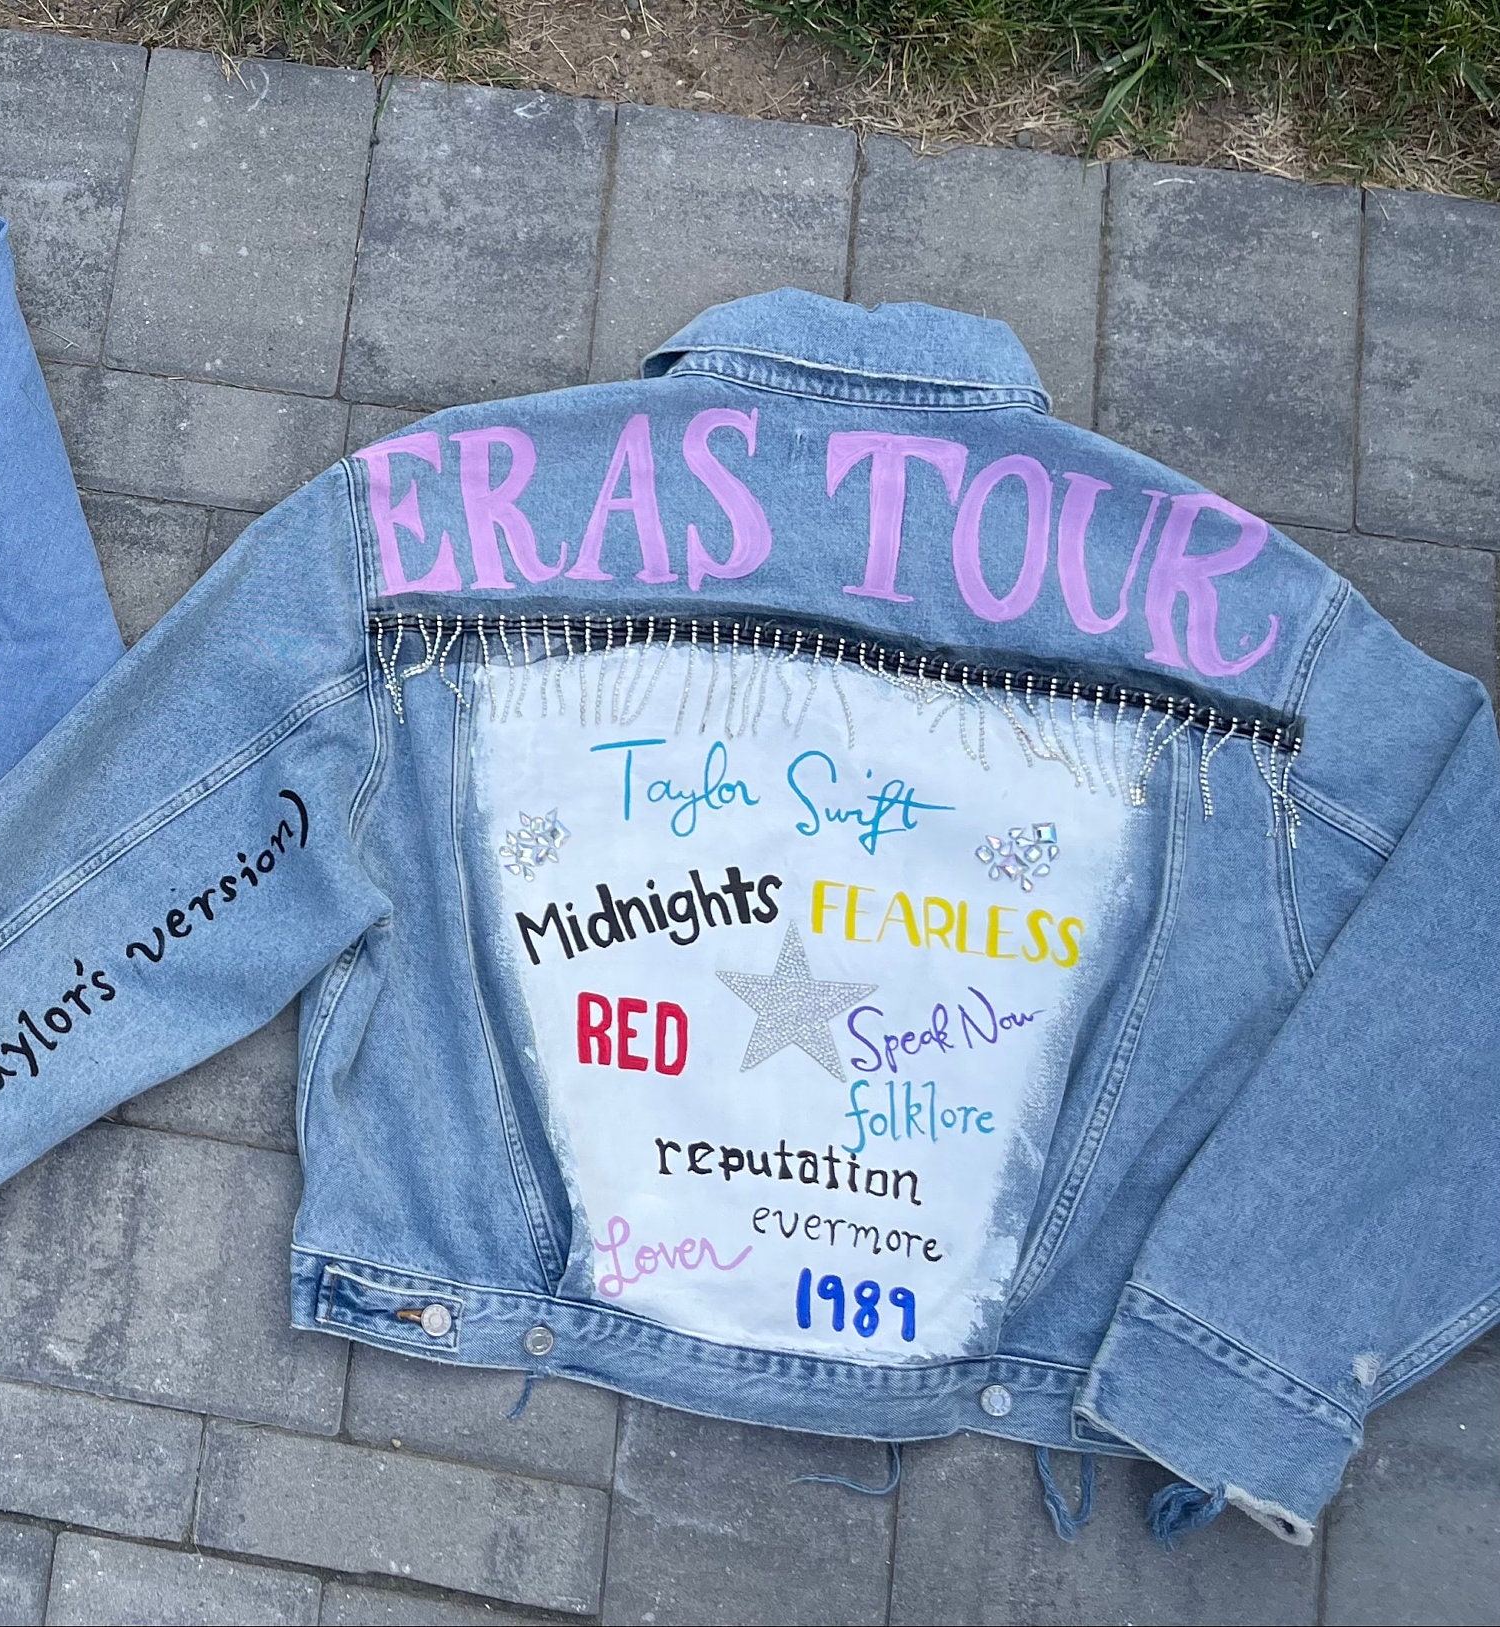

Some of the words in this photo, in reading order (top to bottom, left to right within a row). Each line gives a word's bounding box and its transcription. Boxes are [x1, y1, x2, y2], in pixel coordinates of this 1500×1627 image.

[353, 407, 772, 597] ERAS
[825, 430, 1281, 677] TOUR
[588, 736, 760, 838] Taylor
[786, 750, 956, 855] Swift
[126, 789, 309, 963] version)
[514, 866, 783, 966] Midnights
[810, 879, 1086, 968] FEARLESS
[576, 991, 689, 1077] RED
[846, 1004, 955, 1074] Speak
[965, 986, 1045, 1051] Now
[841, 1079, 996, 1153] folklore
[654, 1136, 922, 1206] reputation
[593, 1215, 754, 1298] Lover
[751, 1206, 944, 1263] evermore
[795, 1266, 916, 1342] 1989
